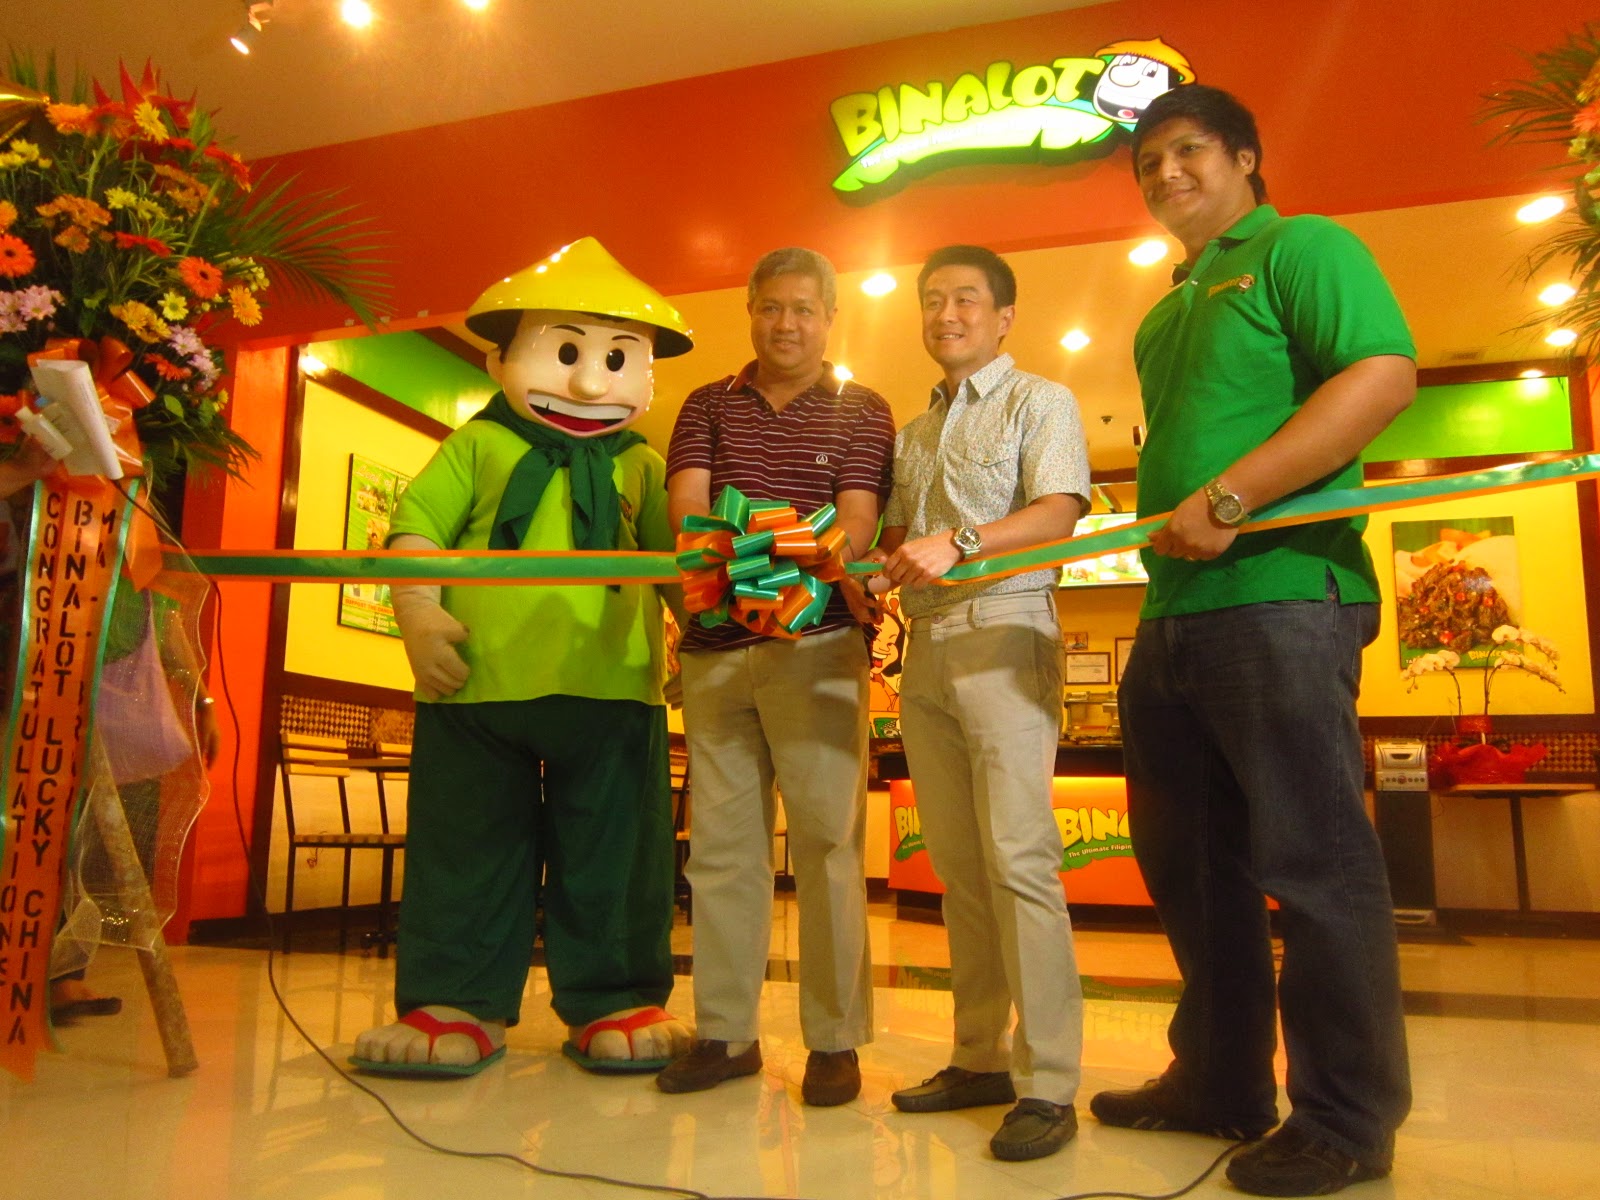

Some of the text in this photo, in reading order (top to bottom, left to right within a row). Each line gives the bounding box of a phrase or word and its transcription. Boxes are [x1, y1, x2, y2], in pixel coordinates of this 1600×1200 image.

[830, 57, 1106, 157] BINALOT
[53, 500, 94, 697] BINALOT
[31, 718, 63, 867] LUCKY
[1081, 845, 1110, 855] Ultimate
[7, 889, 45, 1046] CHINA
